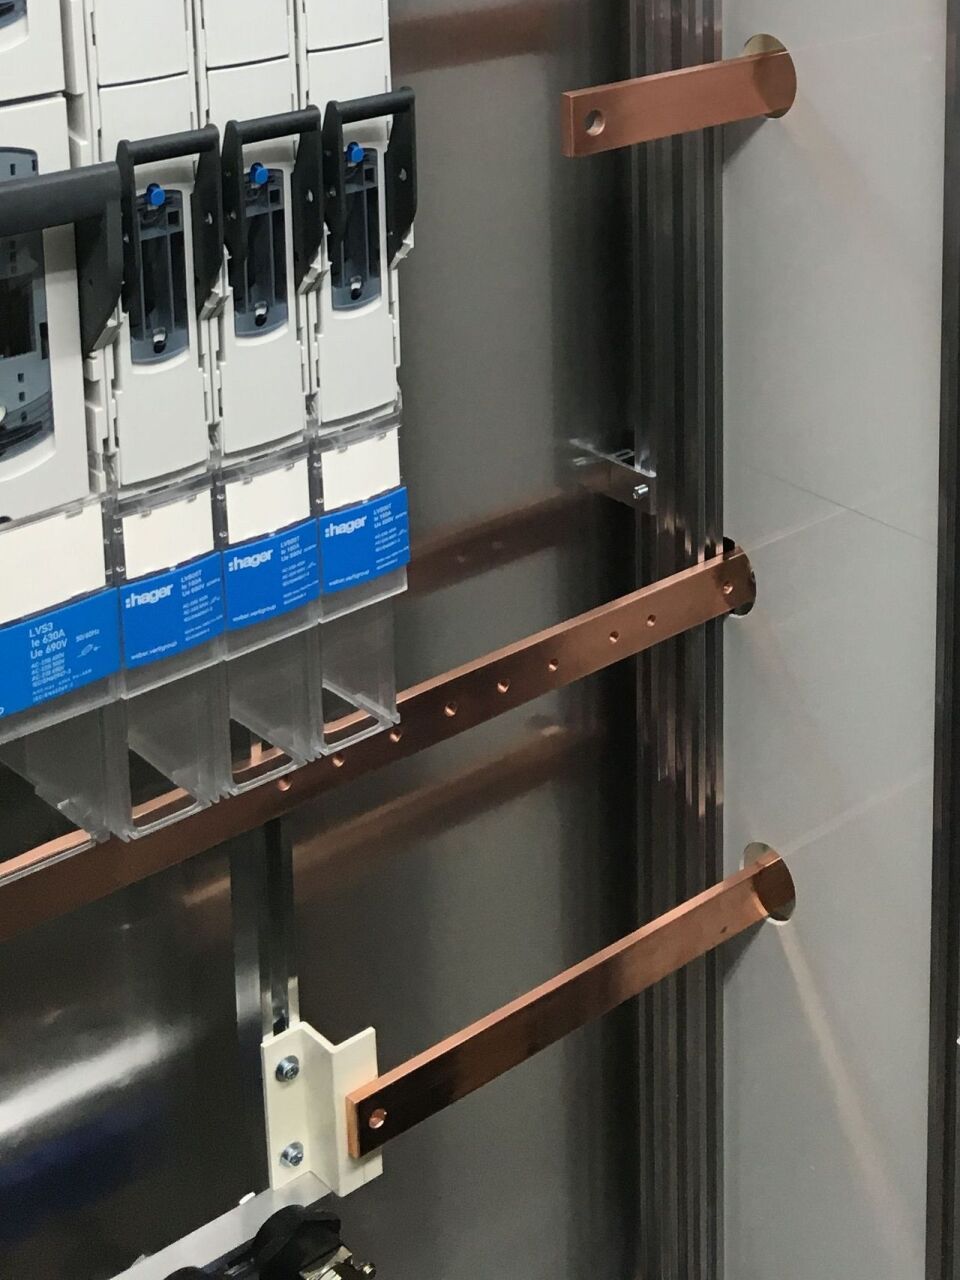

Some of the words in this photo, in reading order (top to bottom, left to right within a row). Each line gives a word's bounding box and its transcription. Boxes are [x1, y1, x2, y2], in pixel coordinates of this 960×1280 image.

[29, 621, 54, 638] LVS3
[42, 628, 66, 644] 630A
[30, 648, 44, 659] Ue
[45, 637, 68, 654] 690V
